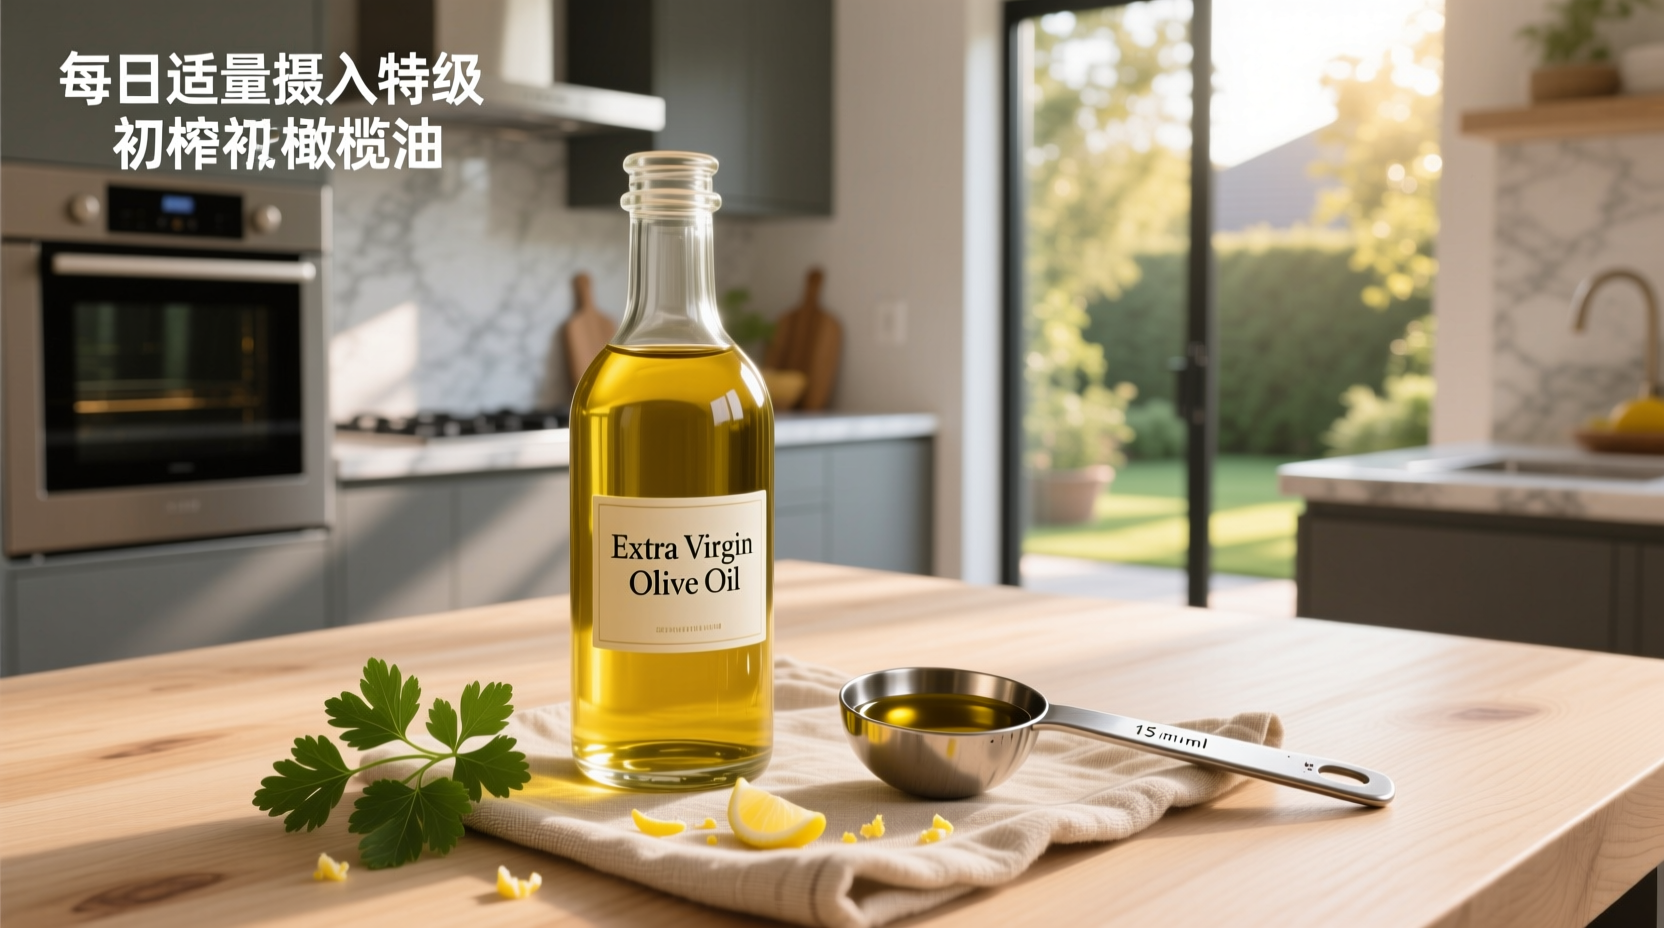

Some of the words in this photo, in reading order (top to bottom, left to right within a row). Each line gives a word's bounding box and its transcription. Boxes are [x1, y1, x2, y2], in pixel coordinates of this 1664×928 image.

[611, 533, 679, 560] Extra
[684, 532, 753, 565] Virgin
[629, 569, 699, 596] Olive
[704, 566, 740, 593] Oil
[1136, 724, 1157, 738] 15
